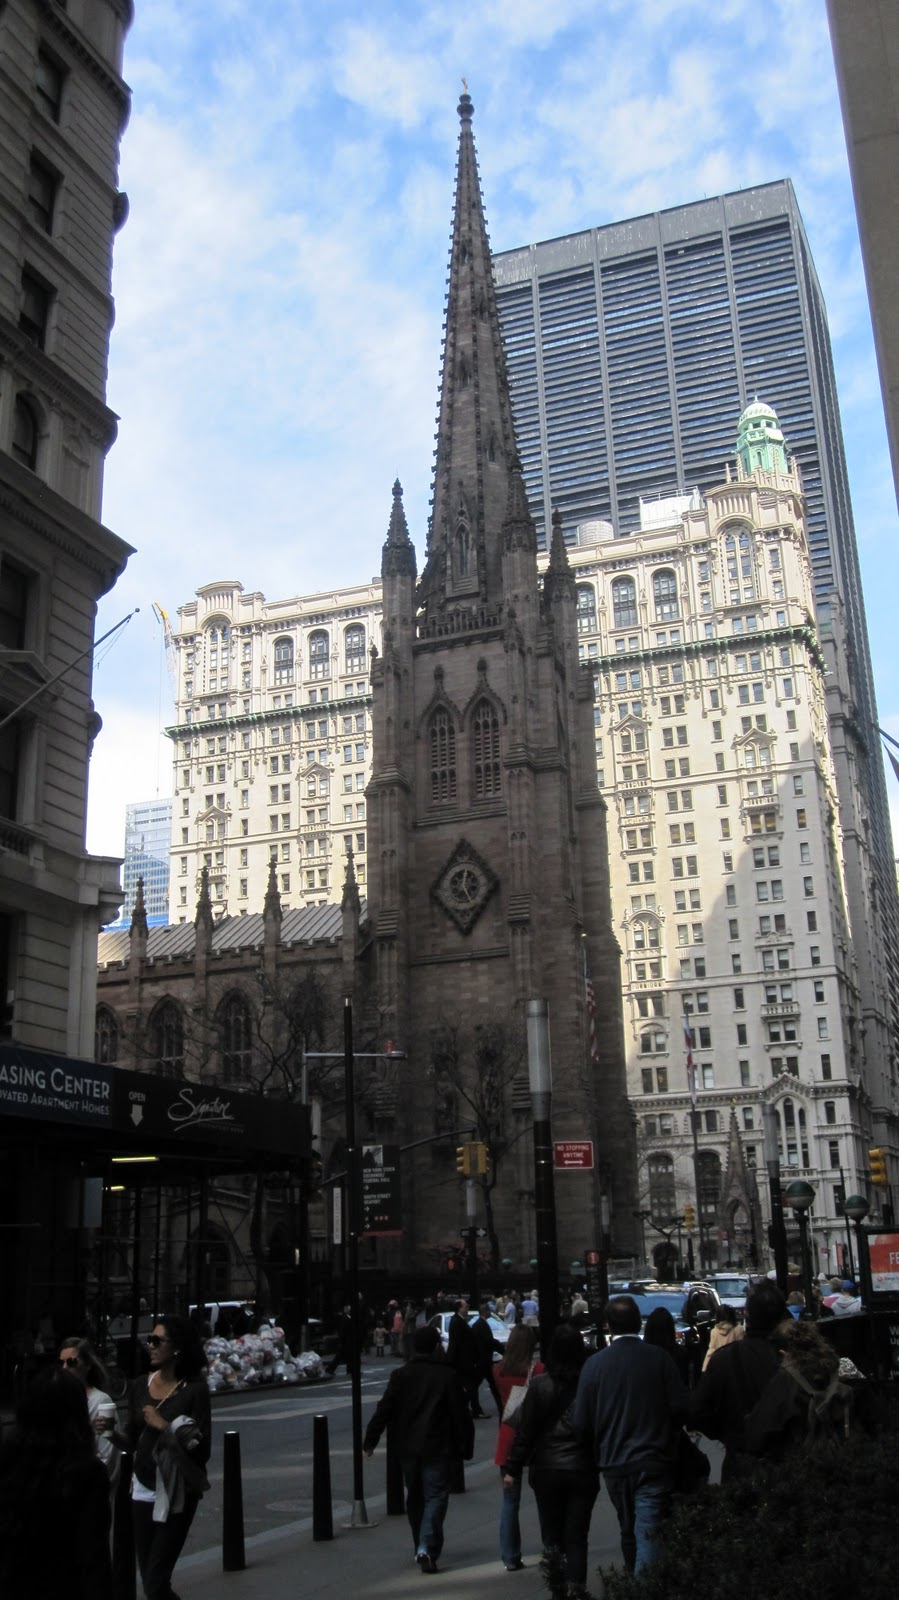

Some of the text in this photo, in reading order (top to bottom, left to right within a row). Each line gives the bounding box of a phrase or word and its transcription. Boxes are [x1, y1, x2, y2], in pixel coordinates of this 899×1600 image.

[0, 1064, 110, 1099] ASING CENTER
[31, 1092, 80, 1111] APARTMENT
[81, 1099, 110, 1115] HOMES
[128, 1091, 146, 1102] OPEN
